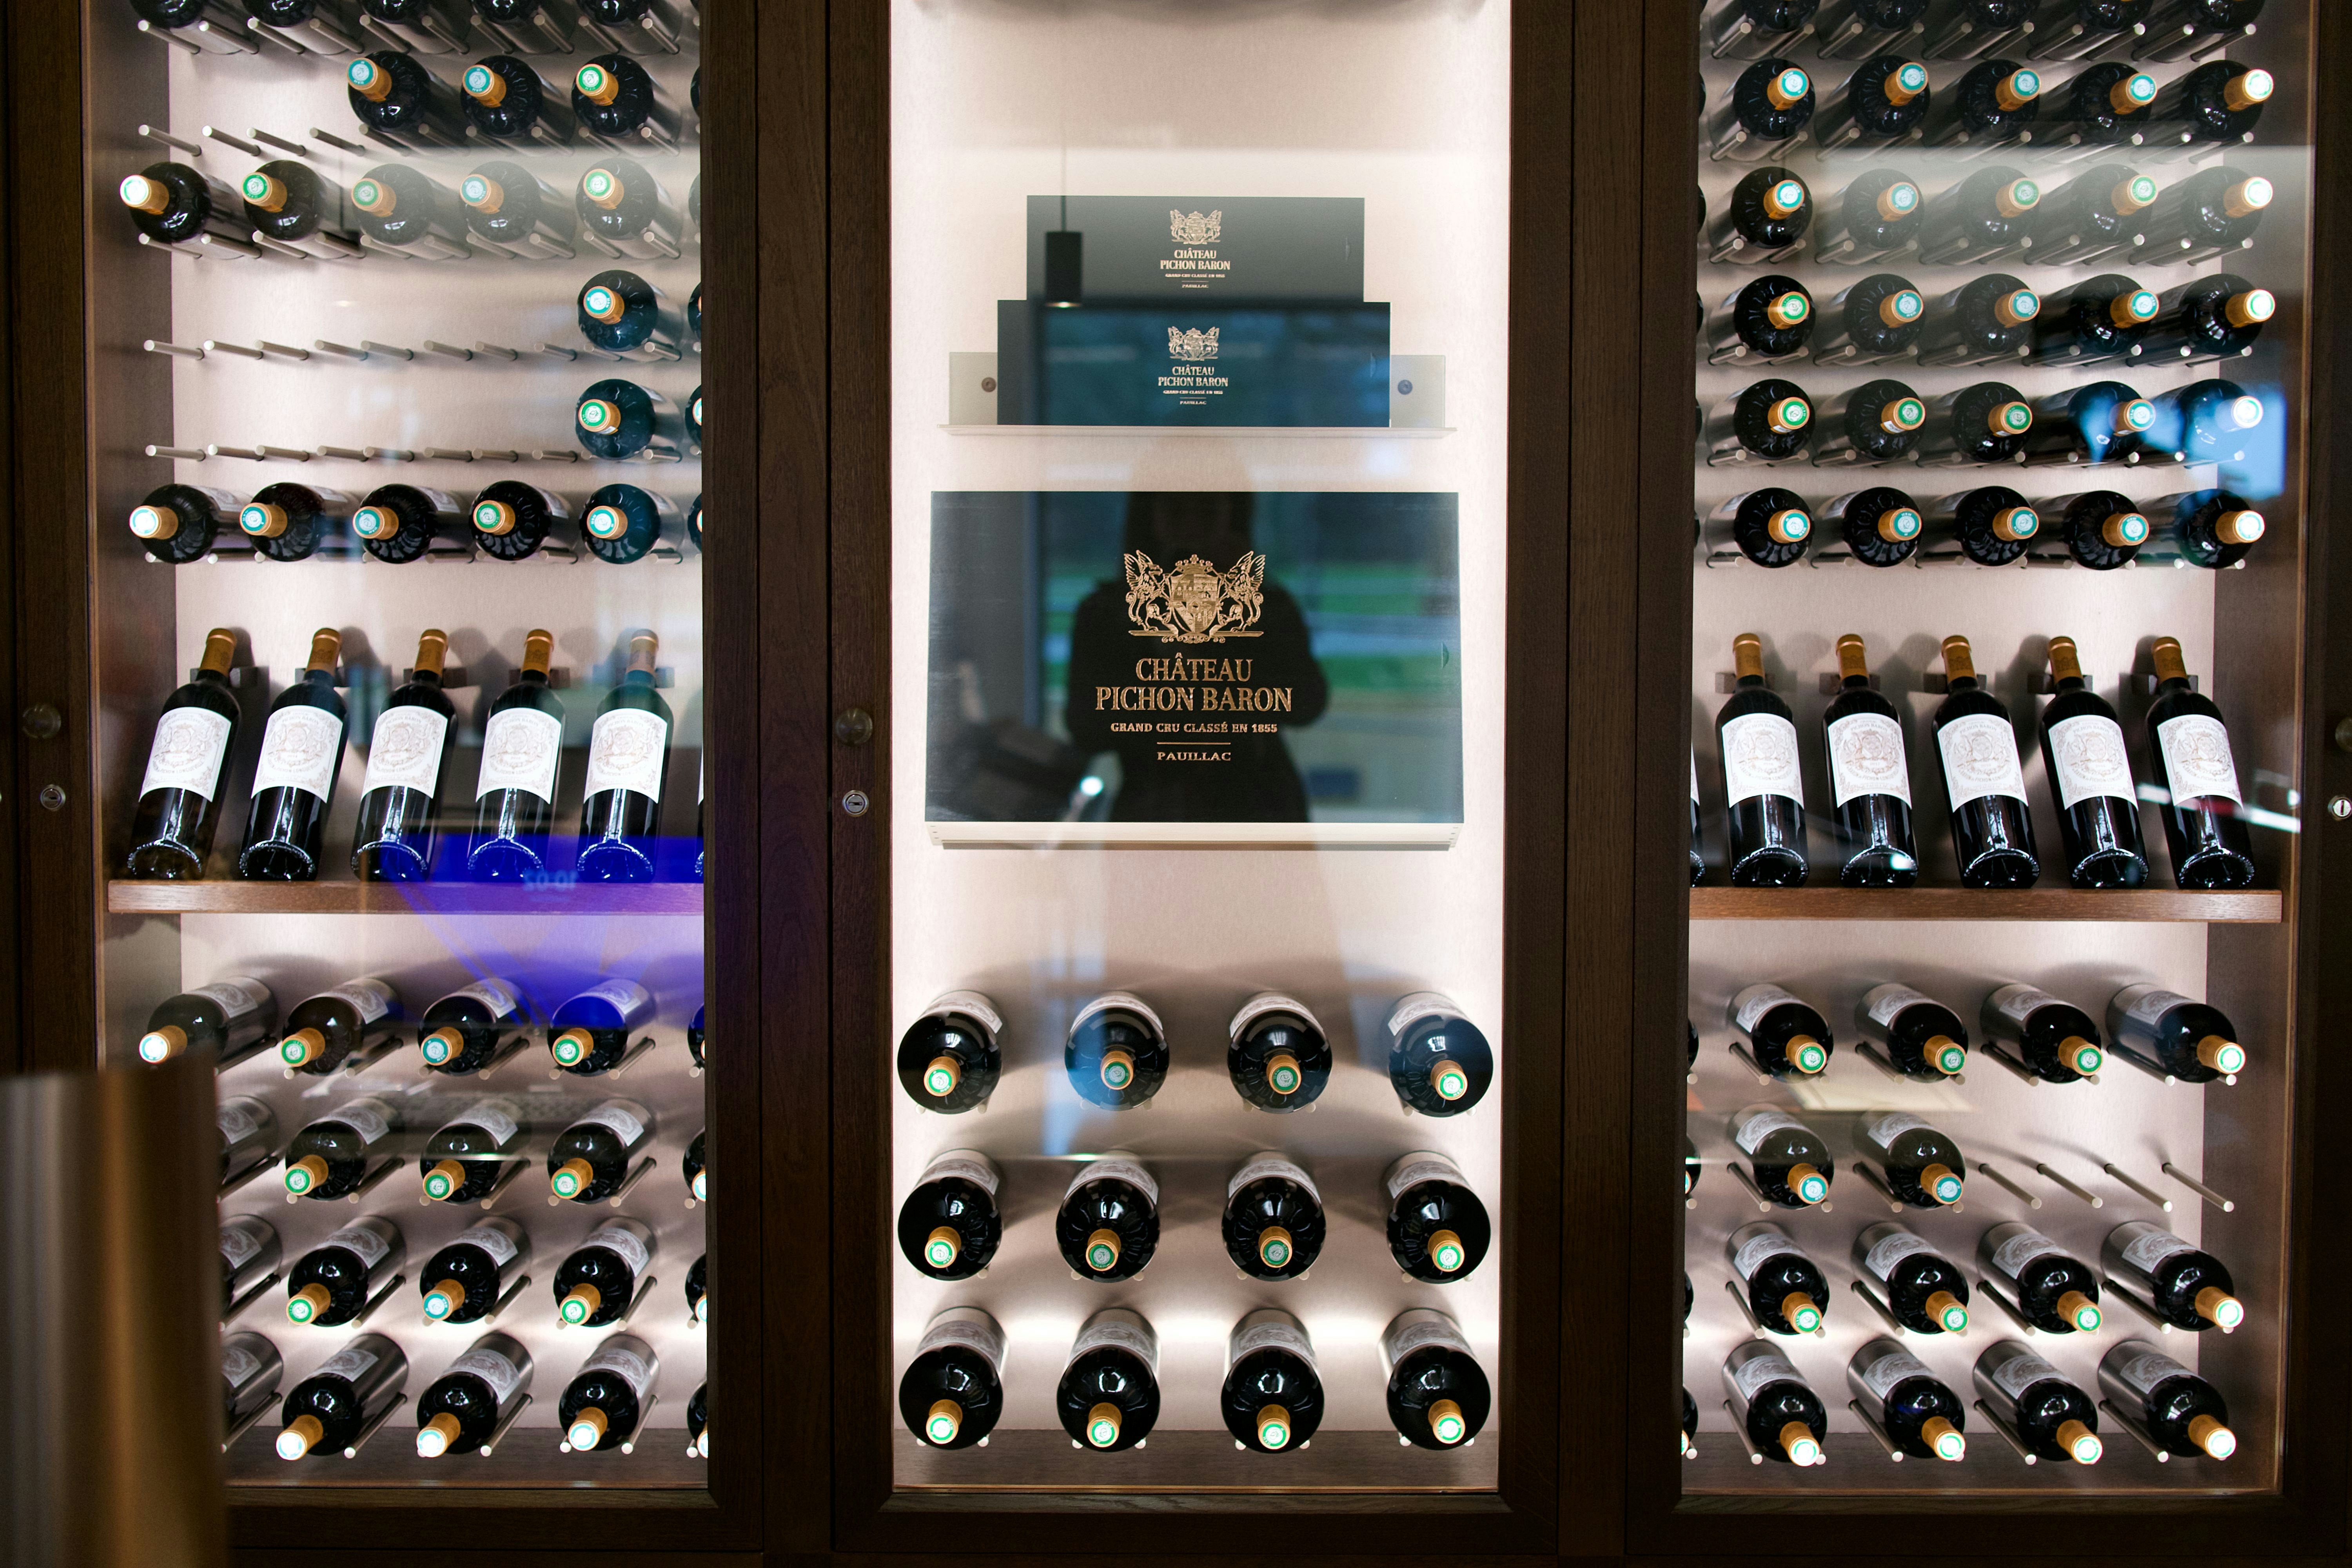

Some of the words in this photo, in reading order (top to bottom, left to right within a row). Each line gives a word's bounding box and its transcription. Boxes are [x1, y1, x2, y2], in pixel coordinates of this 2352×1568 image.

[1174, 247, 1217, 259] CHÂTEAU
[1160, 260, 1196, 270] PICHON
[1198, 260, 1230, 270] BARON
[1172, 364, 1215, 376] CHÂTEAU
[1158, 377, 1194, 386] PICHON
[1196, 377, 1228, 387] BARON
[1136, 652, 1253, 682] CHÂTEAU
[1095, 686, 1195, 711] PICHON
[1201, 687, 1293, 712] BARON
[1111, 722, 1153, 732] GRAND
[1156, 723, 1180, 733] CRU
[1183, 721, 1228, 733] CLASSÉ
[1232, 723, 1248, 733] EN
[1251, 723, 1278, 733] 1855
[1157, 751, 1231, 761] PAUILLAC
